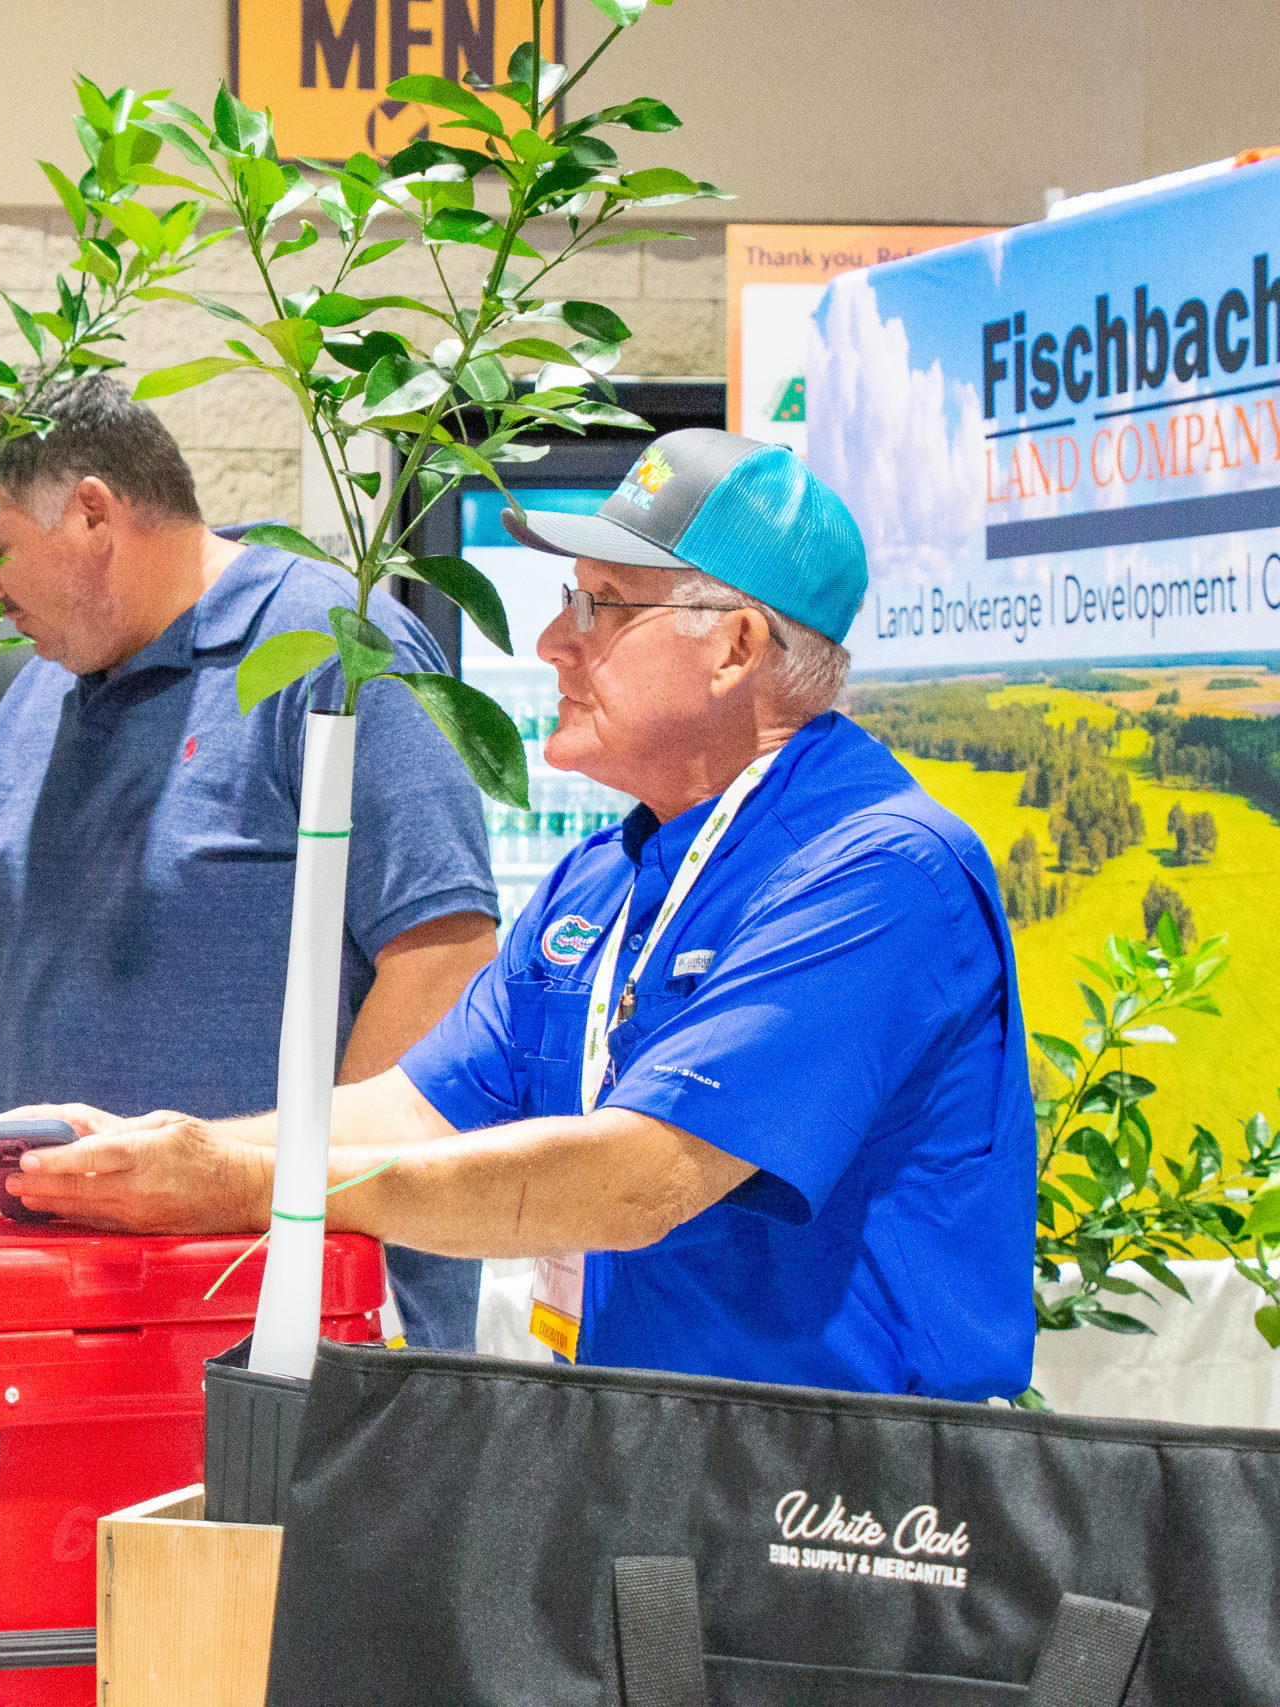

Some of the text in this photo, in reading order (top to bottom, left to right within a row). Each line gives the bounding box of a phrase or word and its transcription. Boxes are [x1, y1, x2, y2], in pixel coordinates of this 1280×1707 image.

[744, 245, 816, 266] Thank
[982, 253, 1280, 420] Fischbach
[985, 435, 1081, 504] LAND
[876, 585, 925, 639] Land
[932, 580, 1043, 644] Brokerage
[1064, 564, 1237, 639] Development
[538, 1319, 569, 1350] EXHIBITOR
[774, 1489, 970, 1557] White Oak
[769, 1543, 969, 1589] BBQ SUPPLY & MERCANTILE
